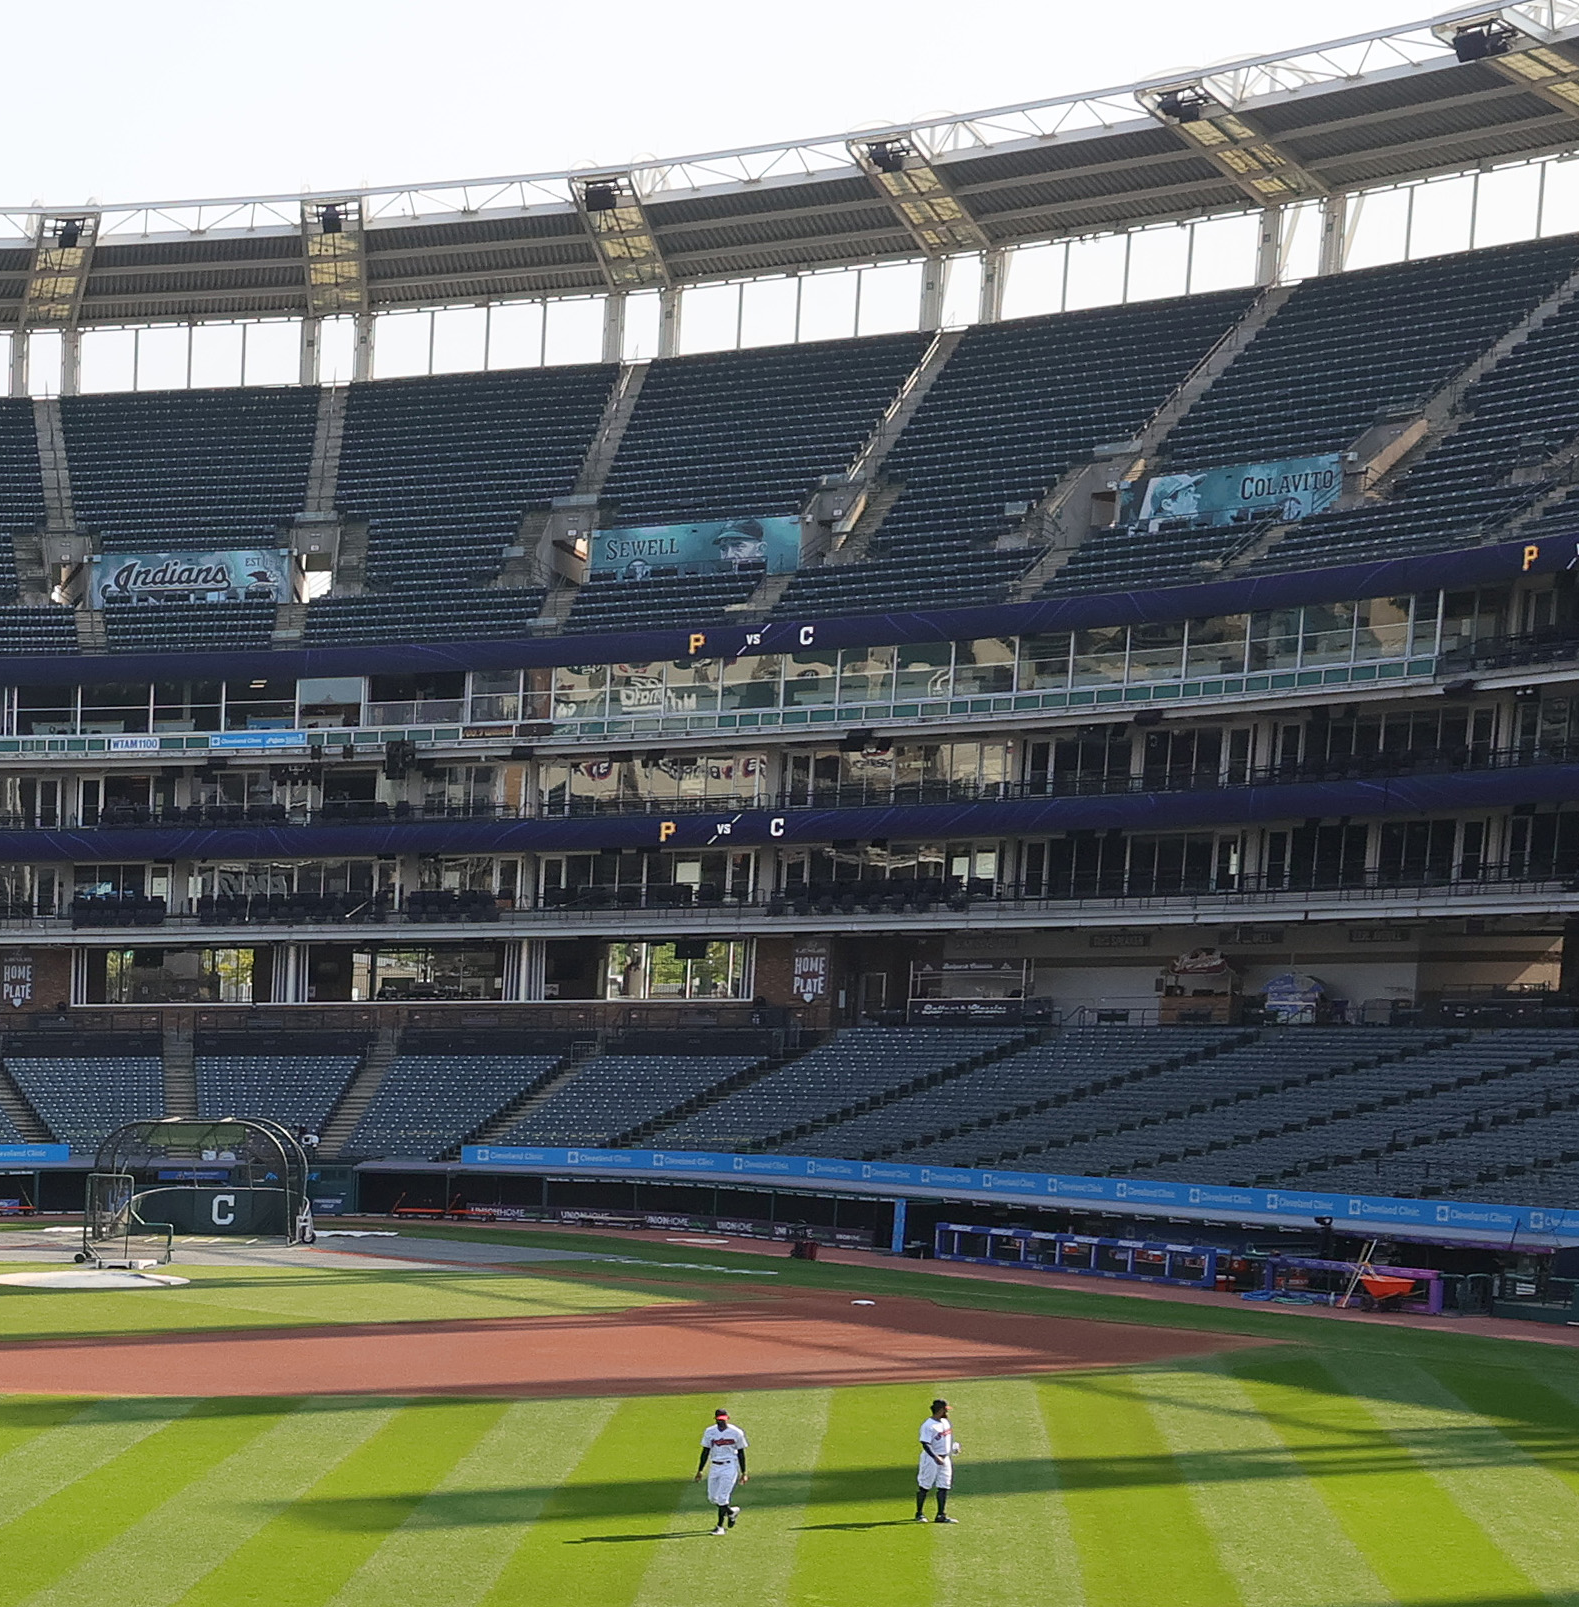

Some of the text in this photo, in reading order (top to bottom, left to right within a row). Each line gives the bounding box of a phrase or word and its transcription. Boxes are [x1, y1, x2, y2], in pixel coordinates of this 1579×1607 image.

[245, 557, 261, 567] EST
[1522, 545, 1540, 571] P
[99, 558, 232, 600] Indians
[689, 632, 705, 654] P
[799, 627, 814, 645] C
[112, 738, 141, 750] WTAM
[659, 822, 676, 842] P
[770, 818, 785, 838] C
[3, 965, 32, 982] HOME
[794, 956, 826, 975] HOME
[3, 983, 32, 1000] PLATE
[793, 977, 825, 995] PLATE
[211, 1194, 236, 1226] C
